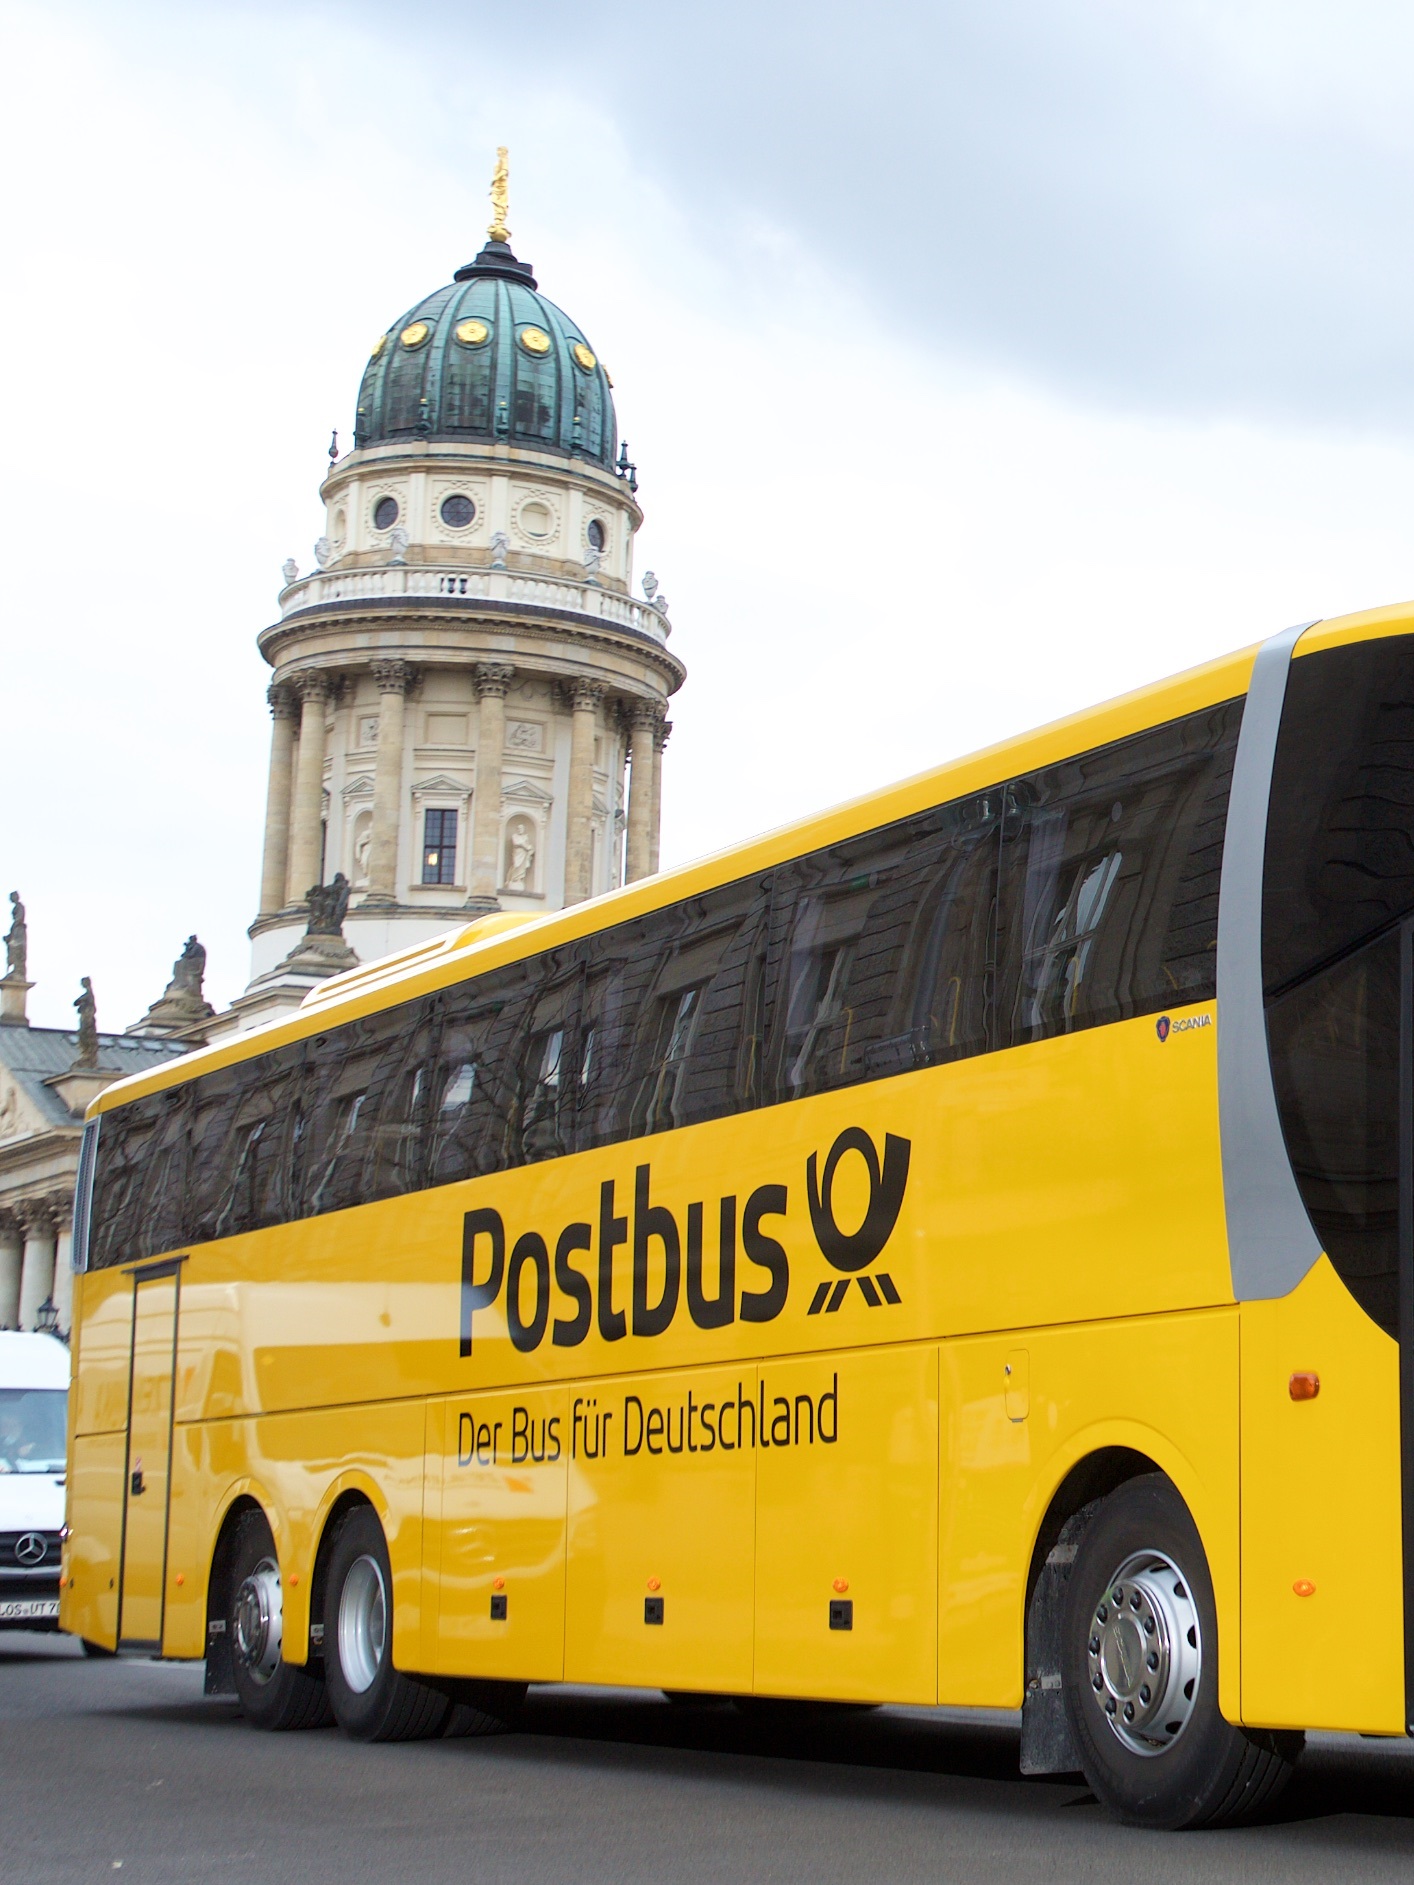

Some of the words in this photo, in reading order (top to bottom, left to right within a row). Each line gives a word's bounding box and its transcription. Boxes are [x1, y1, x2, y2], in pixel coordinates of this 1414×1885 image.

[1172, 1014, 1211, 1033] SCANIA
[459, 1163, 790, 1358] Postbus
[458, 1412, 502, 1467] Der
[512, 1407, 560, 1463] Bus
[572, 1399, 612, 1459] für
[624, 1373, 838, 1456] Deutschland
[30, 1602, 45, 1615] UT
